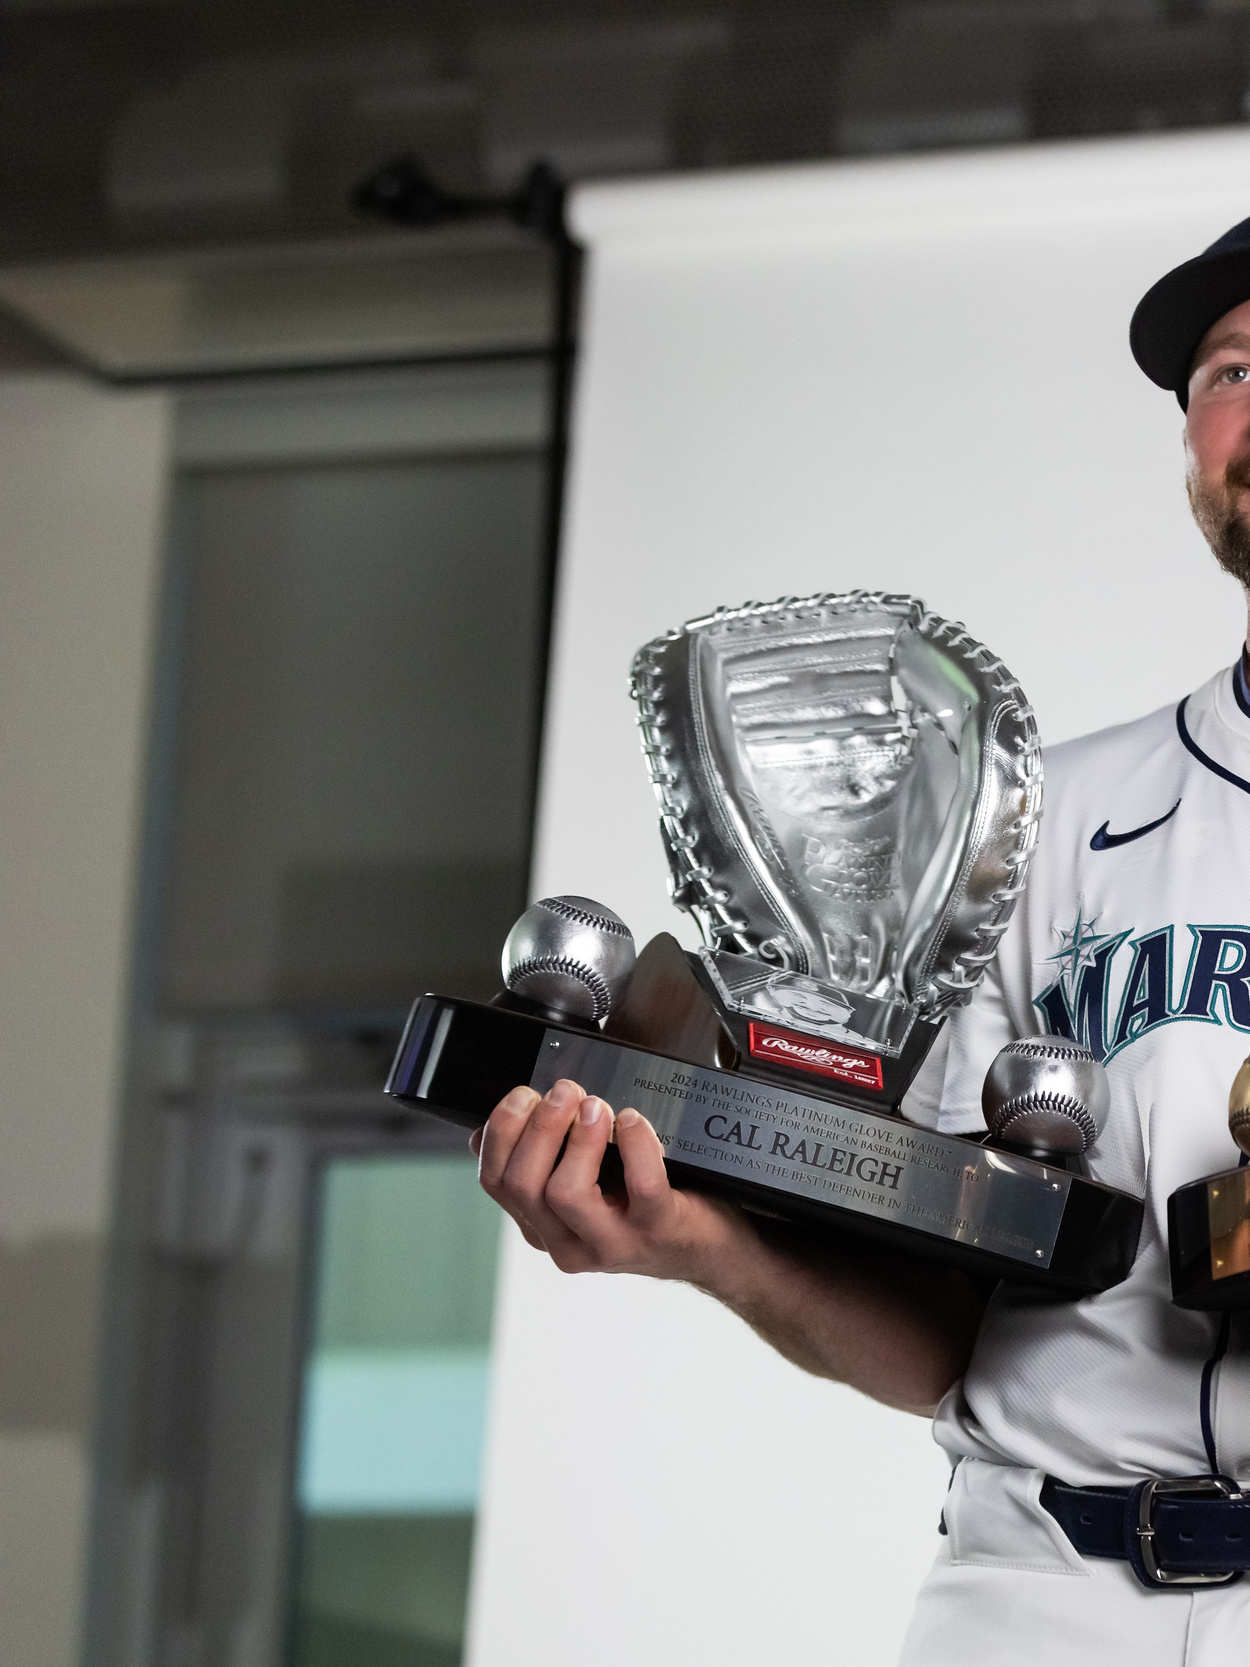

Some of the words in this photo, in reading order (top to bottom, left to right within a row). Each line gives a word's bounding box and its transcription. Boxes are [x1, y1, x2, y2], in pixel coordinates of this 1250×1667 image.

[762, 1037, 870, 1069] Rawlings
[634, 1077, 693, 1100] PRESENTED
[695, 1094, 708, 1104] BY
[711, 1098, 732, 1111] THE
[734, 1104, 778, 1123] SOCIETY
[780, 1117, 801, 1130] FOR
[803, 1124, 858, 1146] AMERICAN
[860, 1140, 908, 1161] BASEBALL
[965, 1170, 979, 1183] TO
[671, 1072, 698, 1089] 2024
[701, 1080, 773, 1108] RAWLINGS
[775, 1100, 849, 1129] PLATINUM
[850, 1122, 894, 1143] GLOVE
[676, 1138, 745, 1165] SELECTION
[746, 1159, 762, 1170] AS
[764, 1162, 789, 1178] THE
[791, 1170, 822, 1186] BEST
[822, 1178, 885, 1205] DEFENDER
[887, 1195, 901, 1209] IN
[904, 1201, 927, 1218] THE
[929, 1209, 987, 1237] AMERICAN
[704, 1114, 763, 1150] CAL
[768, 1131, 904, 1190] RALEIGH
